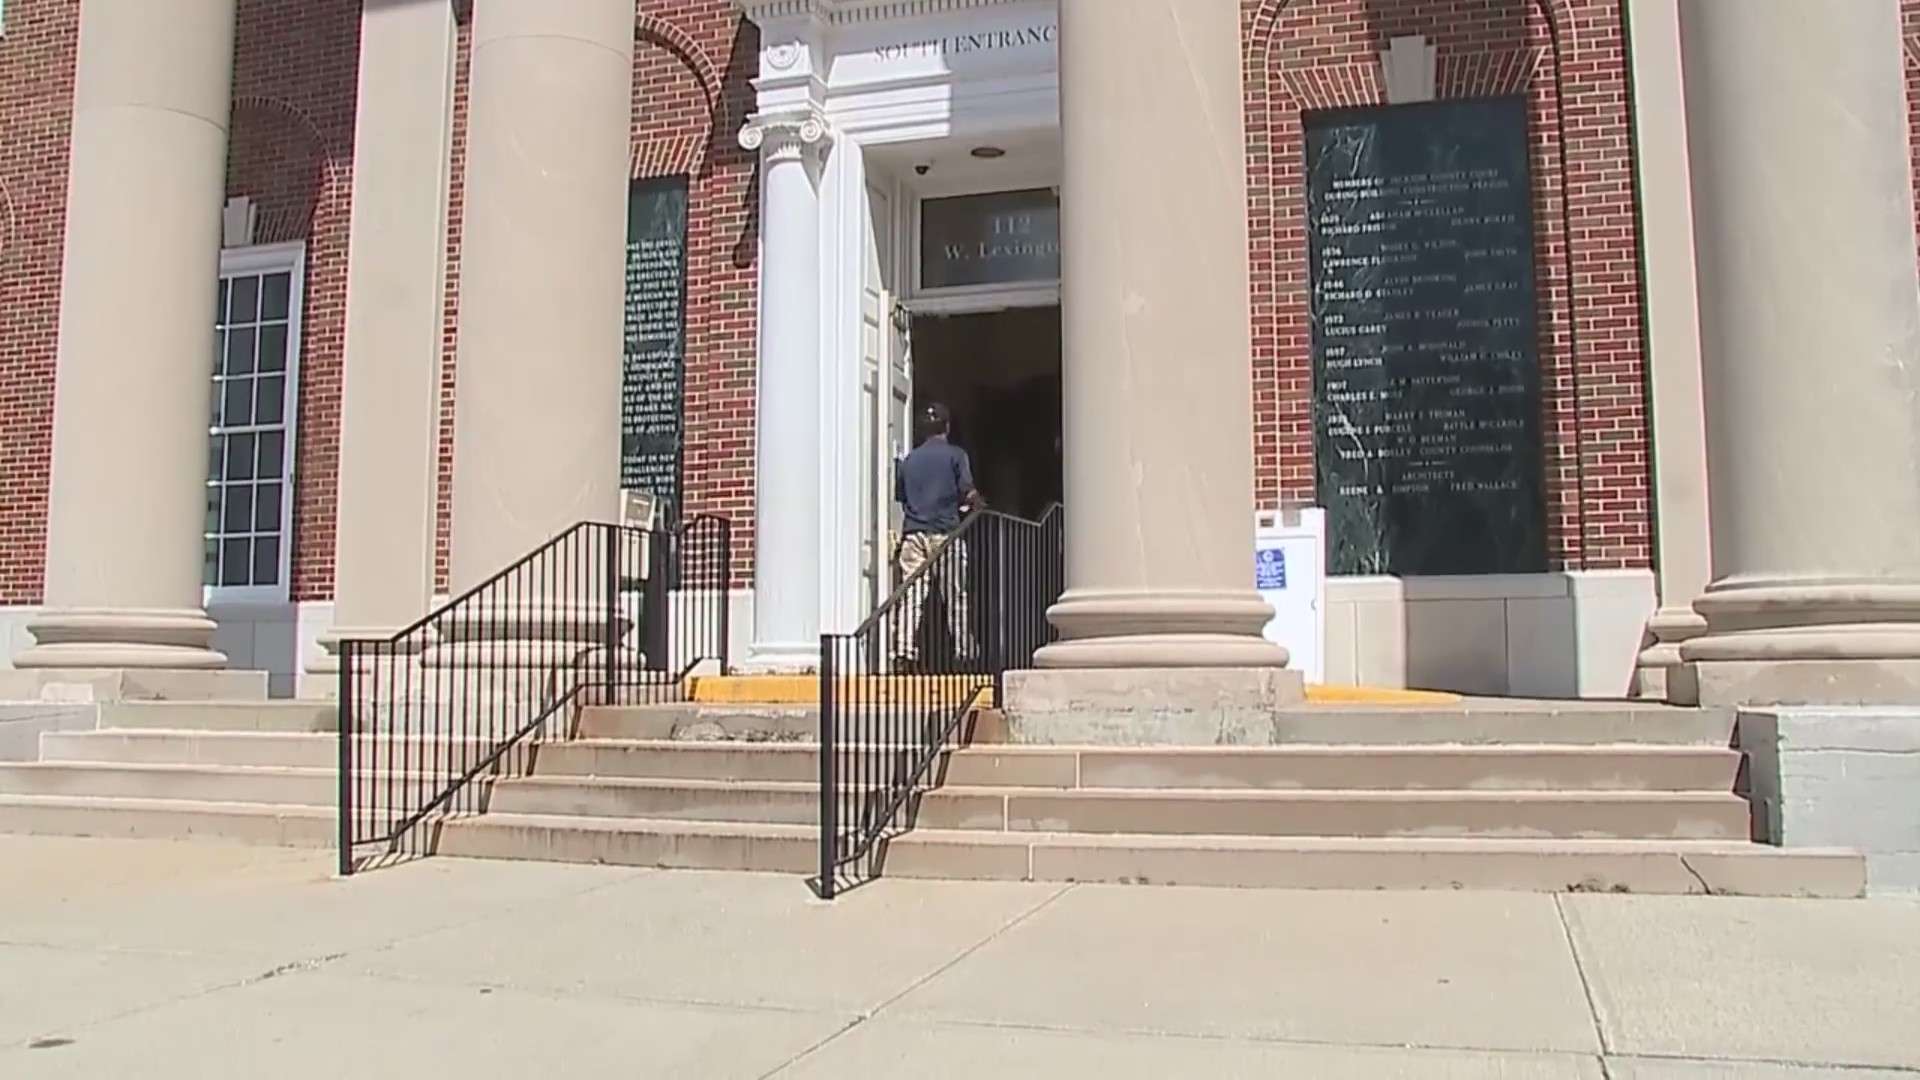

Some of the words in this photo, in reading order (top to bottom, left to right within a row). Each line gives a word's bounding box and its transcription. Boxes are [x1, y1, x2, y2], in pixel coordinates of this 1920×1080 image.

[875, 38, 947, 63] SOUTH
[954, 23, 1057, 54] ENTRANC
[1333, 177, 1371, 189] MEMBERS
[1324, 190, 1358, 202] DURING
[994, 216, 1031, 235] 112
[1320, 224, 1360, 236] RICHARD
[1323, 255, 1369, 269] LAWRENCE
[1323, 288, 1363, 301] RICHARD
[1325, 325, 1357, 337] LUCIUS
[1326, 357, 1352, 369] HUGH
[1353, 355, 1383, 368] LYNCH
[1326, 390, 1367, 403] CHARLES
[1429, 407, 1466, 419] TRUMAN
